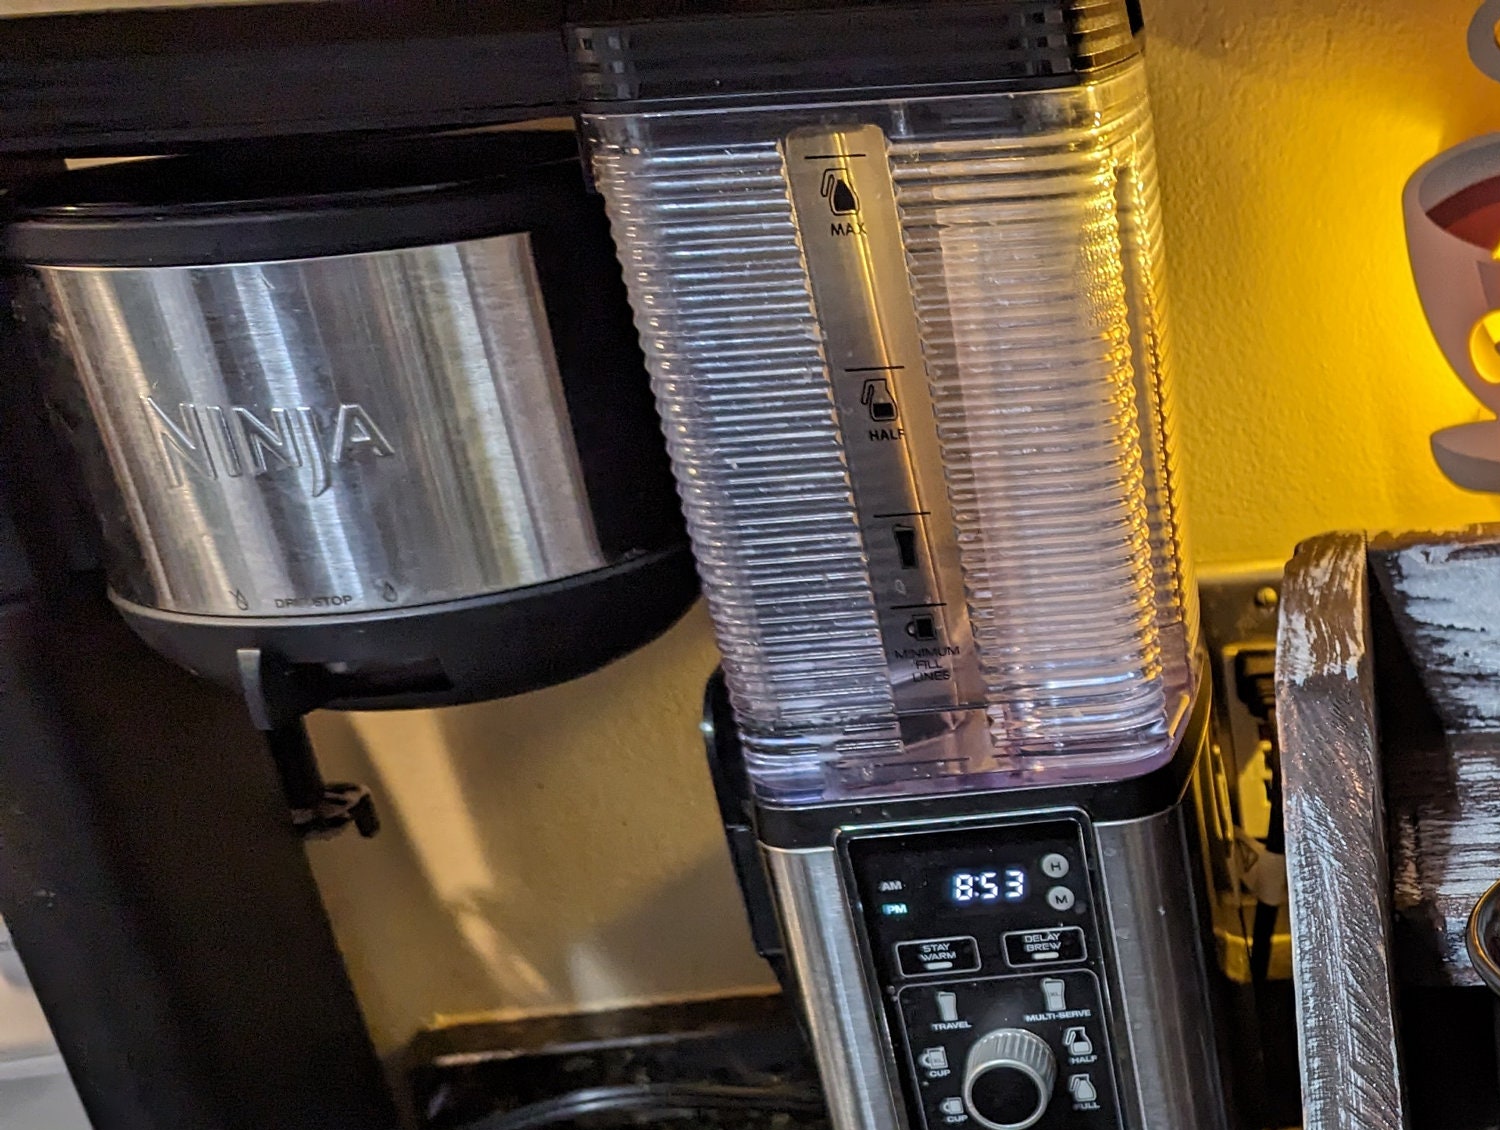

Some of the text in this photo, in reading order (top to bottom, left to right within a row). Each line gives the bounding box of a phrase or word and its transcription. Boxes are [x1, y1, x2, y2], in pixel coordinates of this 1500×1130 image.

[830, 223, 867, 237] MAX
[868, 428, 906, 441] HALF
[139, 396, 396, 498] NINJA
[274, 595, 352, 609] DR STOP
[894, 646, 961, 659] MINIMUM
[915, 660, 943, 670] FILL
[912, 670, 951, 682] LINES
[879, 880, 903, 892] AM
[954, 868, 1025, 902] 8:53
[1055, 894, 1068, 905] M
[881, 902, 908, 915] PM
[1023, 932, 1062, 943] DELAY
[921, 943, 951, 953] STAY
[1025, 941, 1062, 952] BREW
[919, 951, 957, 961] WARM
[1024, 1009, 1092, 1022] MULTI-SERVE
[932, 1021, 972, 1031] TRAVEL
[1070, 1055, 1099, 1065] HALF
[928, 1069, 951, 1079] CUP
[1072, 1102, 1101, 1112] FULL
[945, 1115, 969, 1125] CUP
